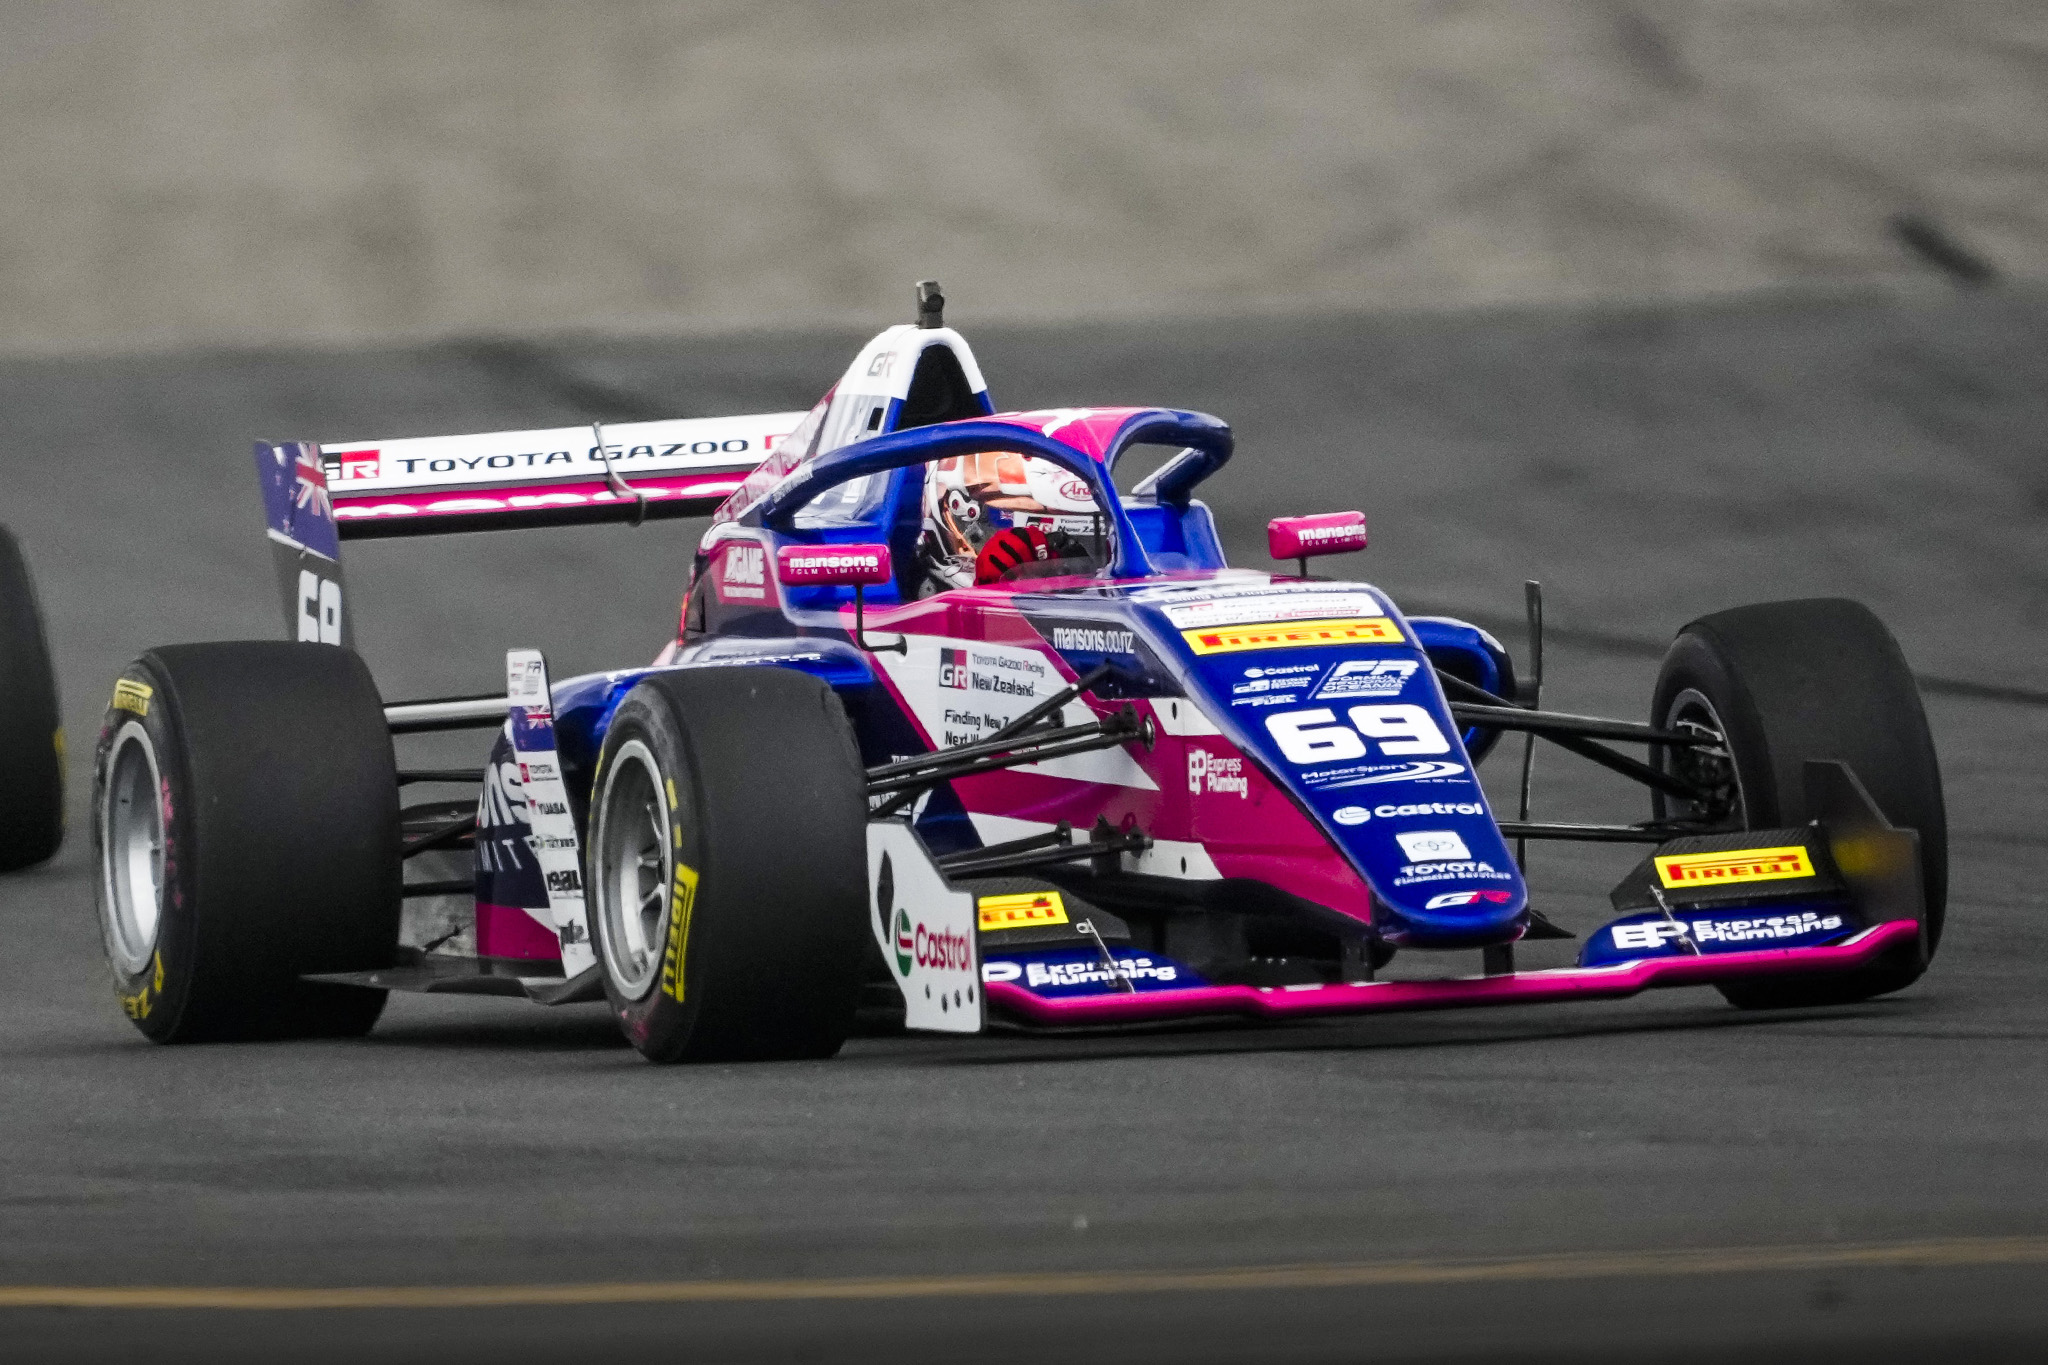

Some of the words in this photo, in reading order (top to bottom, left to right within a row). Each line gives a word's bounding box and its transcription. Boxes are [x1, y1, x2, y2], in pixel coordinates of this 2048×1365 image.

[867, 351, 898, 377] GR
[396, 449, 573, 473] TOYOTA
[588, 439, 749, 462] GAZOO
[1297, 524, 1366, 540] mansons
[789, 556, 879, 568] mansons
[1053, 627, 1135, 653] mansons.co.nz
[1198, 624, 1387, 648] PIRELLI
[939, 657, 967, 690] GR
[972, 653, 997, 666] TOYOTA
[1023, 660, 1045, 678] Racing
[1264, 664, 1320, 676] Castrol
[972, 672, 992, 691] New
[993, 675, 1034, 697] Zealand
[945, 709, 981, 730] Finding
[1265, 704, 1451, 764] 69
[1207, 753, 1242, 777] Express
[1207, 772, 1248, 799] Plumbing
[1374, 802, 1484, 818] Castrol
[1400, 862, 1495, 877] TOYOTA
[1666, 854, 1802, 881] PIRELLI
[979, 905, 1056, 922] ELLI
[1692, 912, 1818, 932] Express
[1696, 916, 1843, 942] Plumbing
[915, 922, 972, 971] Castrol
